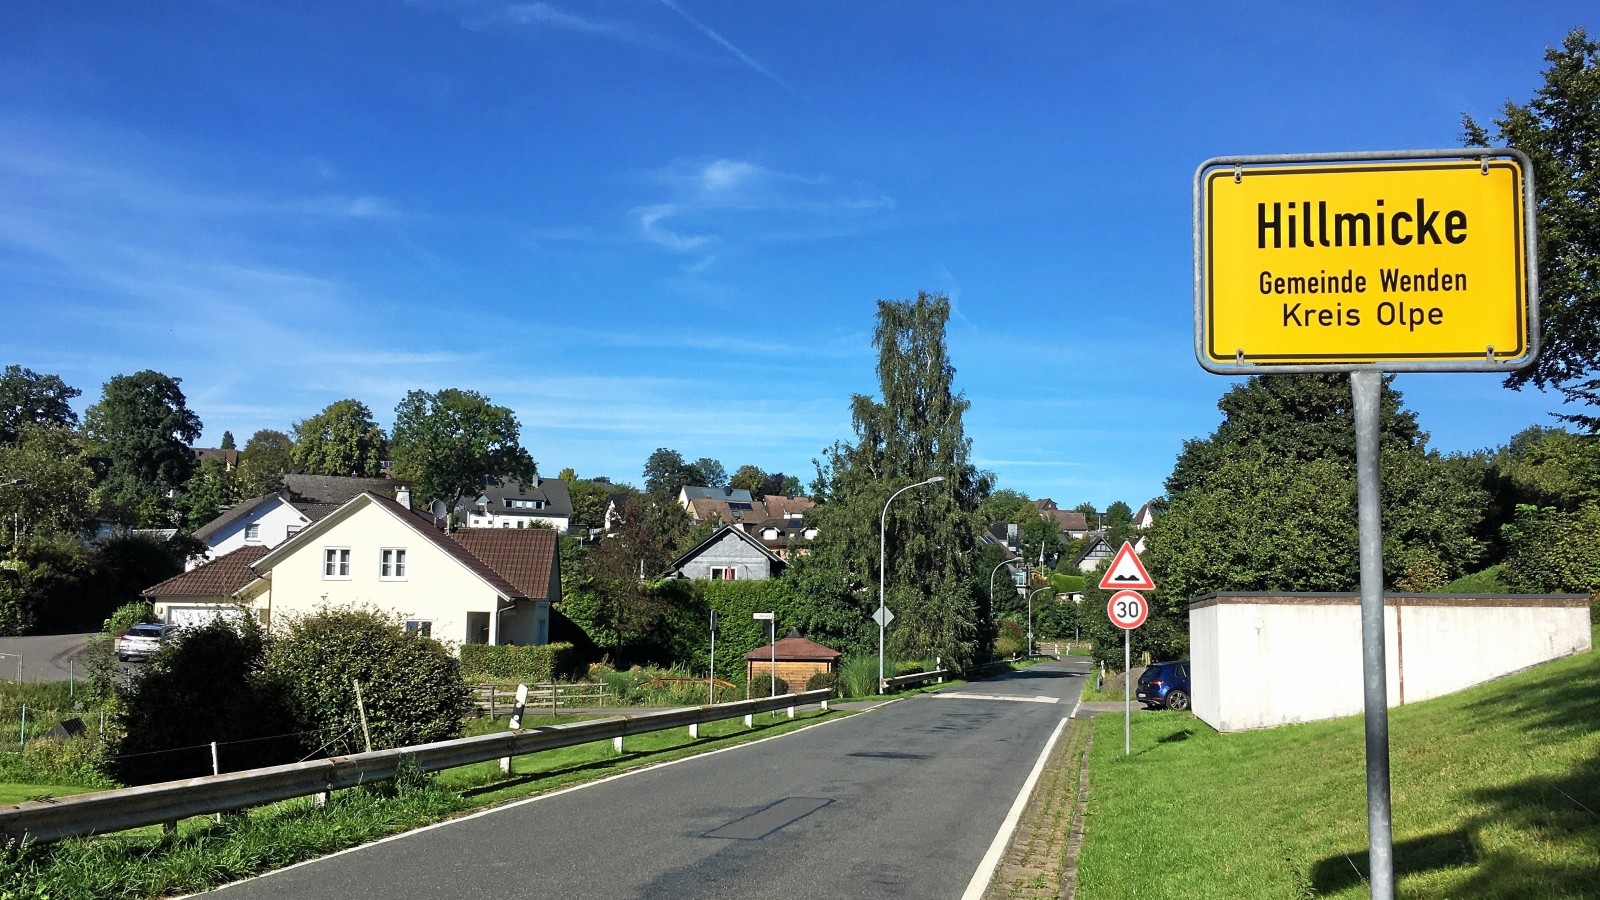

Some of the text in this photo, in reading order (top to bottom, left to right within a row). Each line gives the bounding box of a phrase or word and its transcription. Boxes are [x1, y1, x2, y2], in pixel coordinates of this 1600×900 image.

[1258, 198, 1467, 248] Hillmicke
[1259, 268, 1467, 294] Gemeinde Wenden
[1283, 302, 1443, 331] Kreis Olpe
[1116, 601, 1139, 618] 30
